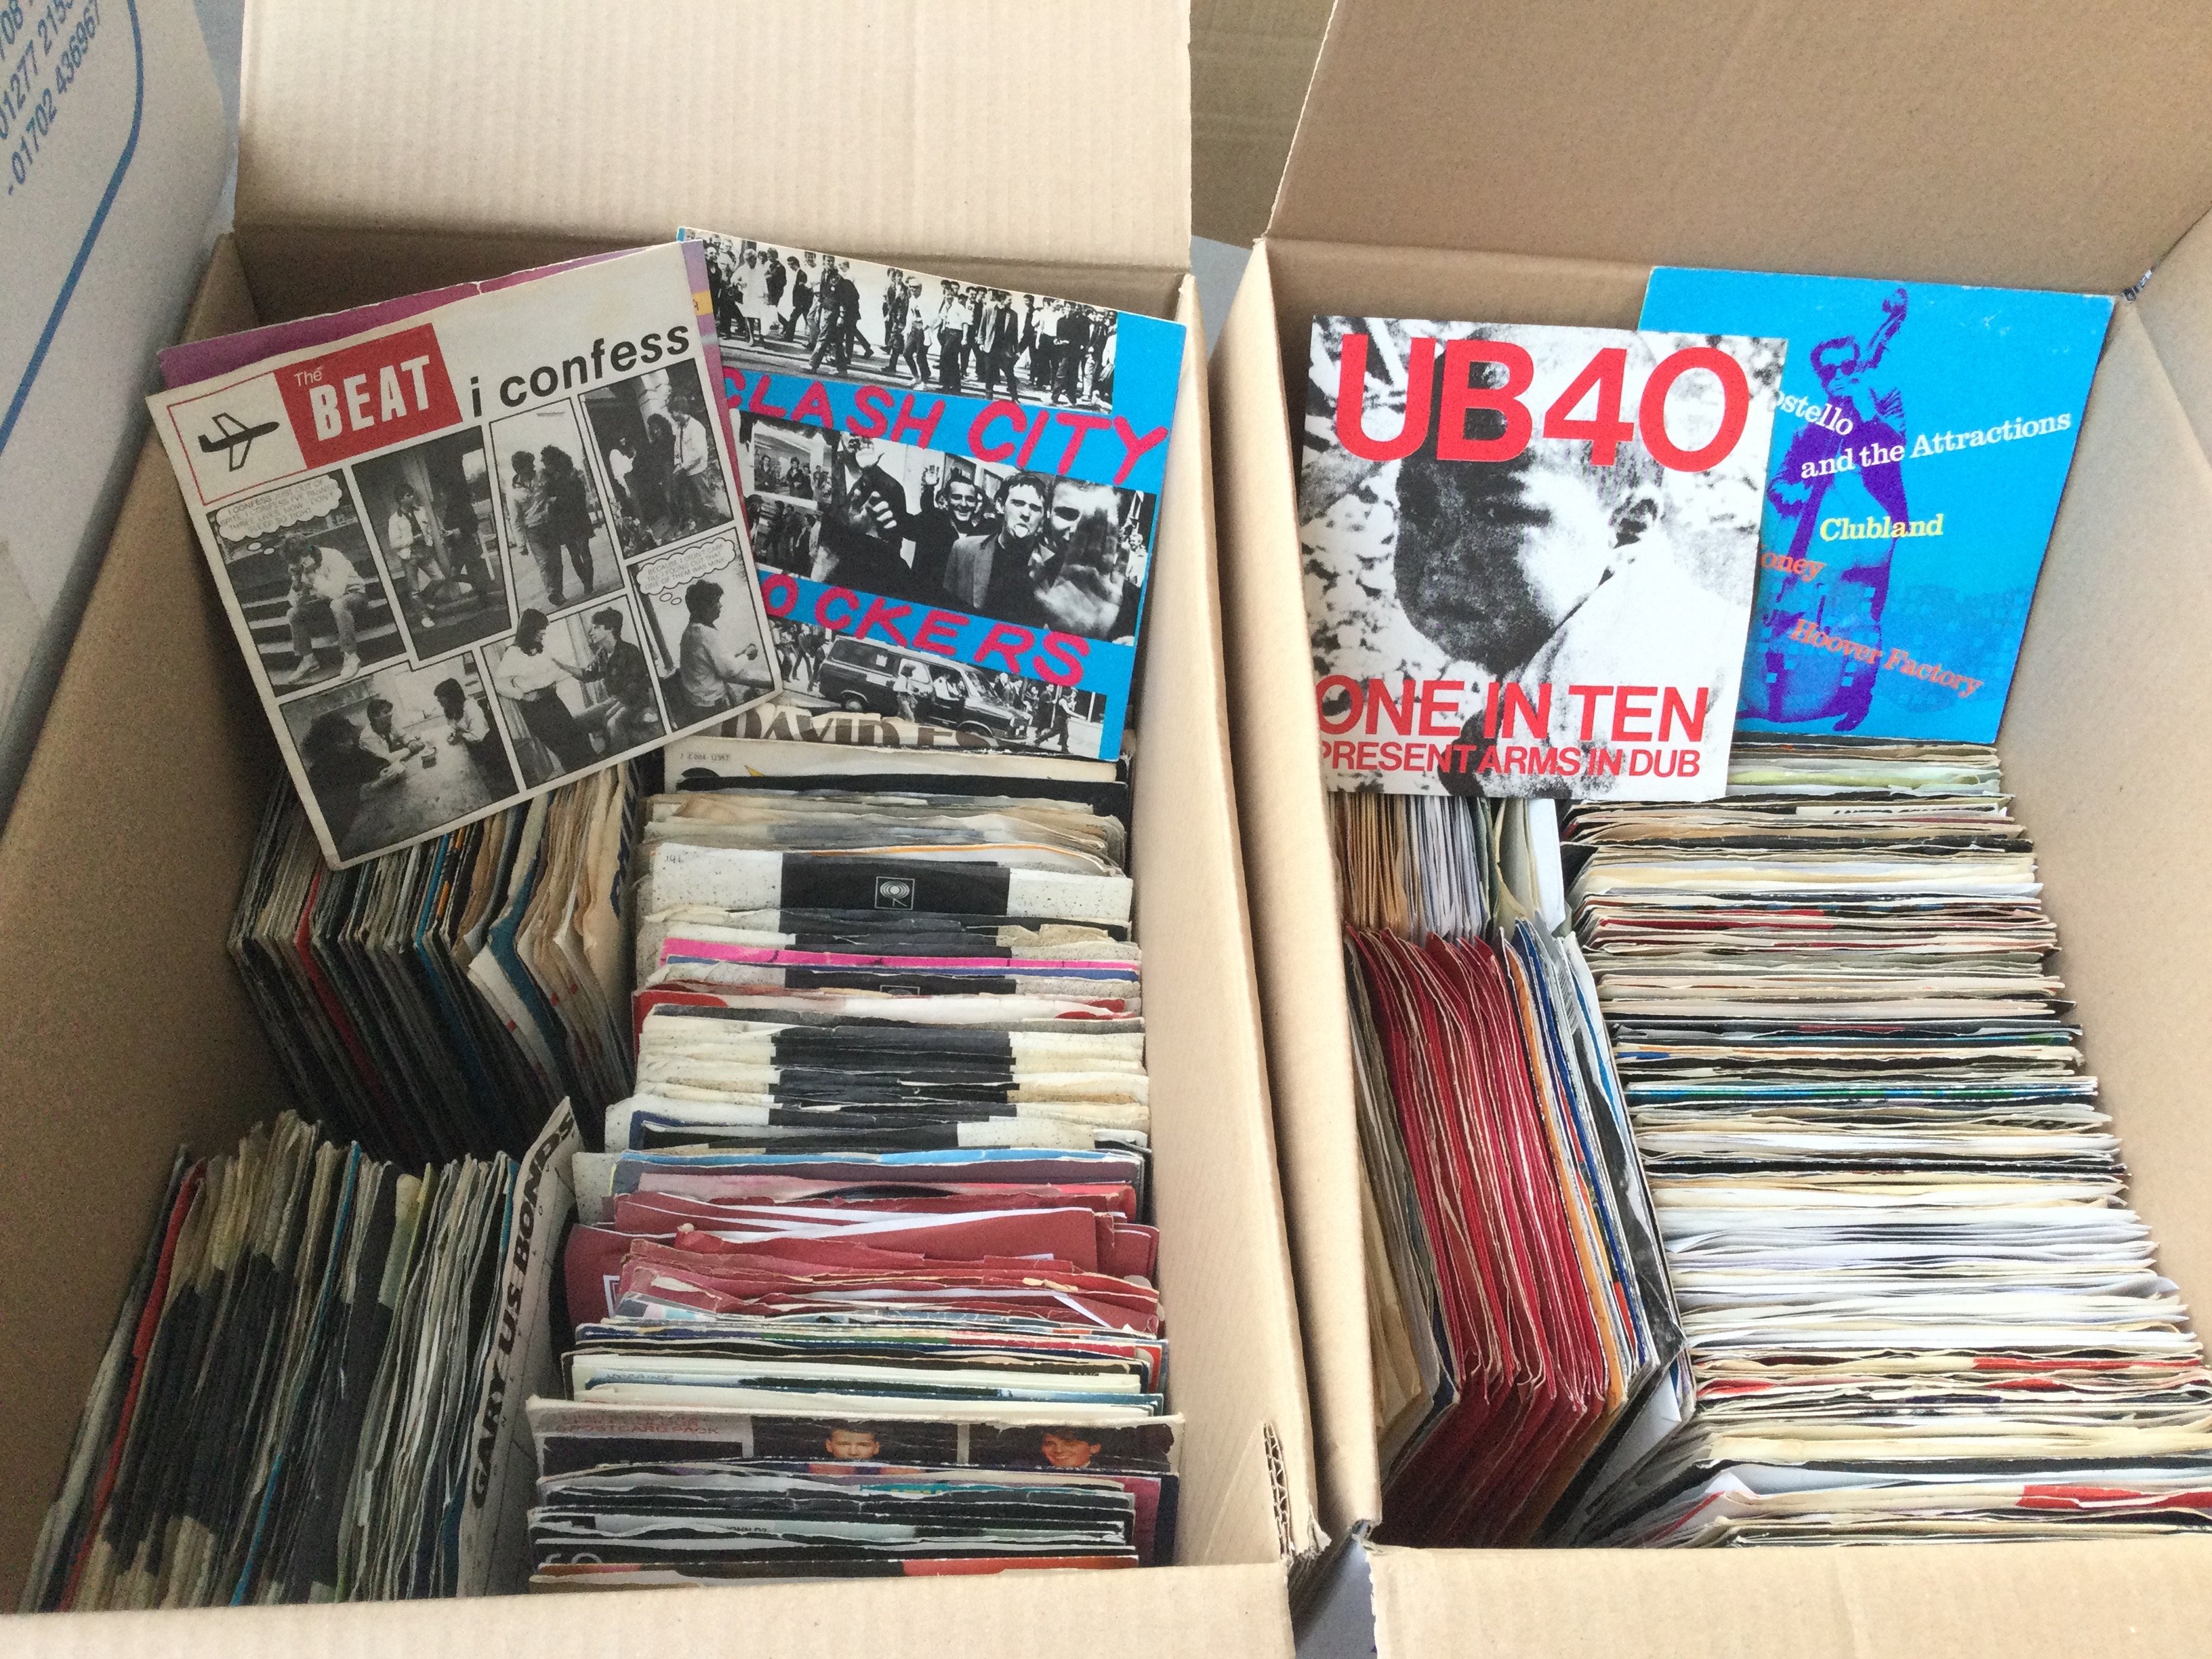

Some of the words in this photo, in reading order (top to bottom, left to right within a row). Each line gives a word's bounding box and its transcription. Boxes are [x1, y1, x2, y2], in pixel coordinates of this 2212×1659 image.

[12, 88, 57, 184] 01702
[294, 367, 323, 388] The
[308, 355, 430, 442] BEAT
[470, 376, 482, 417] i
[499, 325, 690, 407] confess
[1335, 333, 1751, 472] UB40
[968, 400, 1170, 487] CITY
[1801, 448, 1856, 479] and
[1859, 442, 1905, 468] the
[1910, 413, 2072, 459] Attractions
[232, 495, 272, 514] CONFESS
[1820, 514, 1944, 541] Clubland
[1761, 548, 1826, 581] oney
[761, 573, 1091, 687] OCKERS
[1790, 618, 1883, 664] Hoover
[1884, 648, 1984, 698] Factory
[1315, 675, 1465, 736] ONE
[1483, 682, 1552, 739] IN
[1568, 685, 1709, 742] TEN
[1477, 745, 1581, 776] ARMS
[1588, 749, 1626, 776] IN
[1629, 750, 1700, 777] DUB
[472, 1359, 507, 1509] GARY
[498, 1282, 523, 1355] US
[513, 1111, 575, 1275] BONDS
